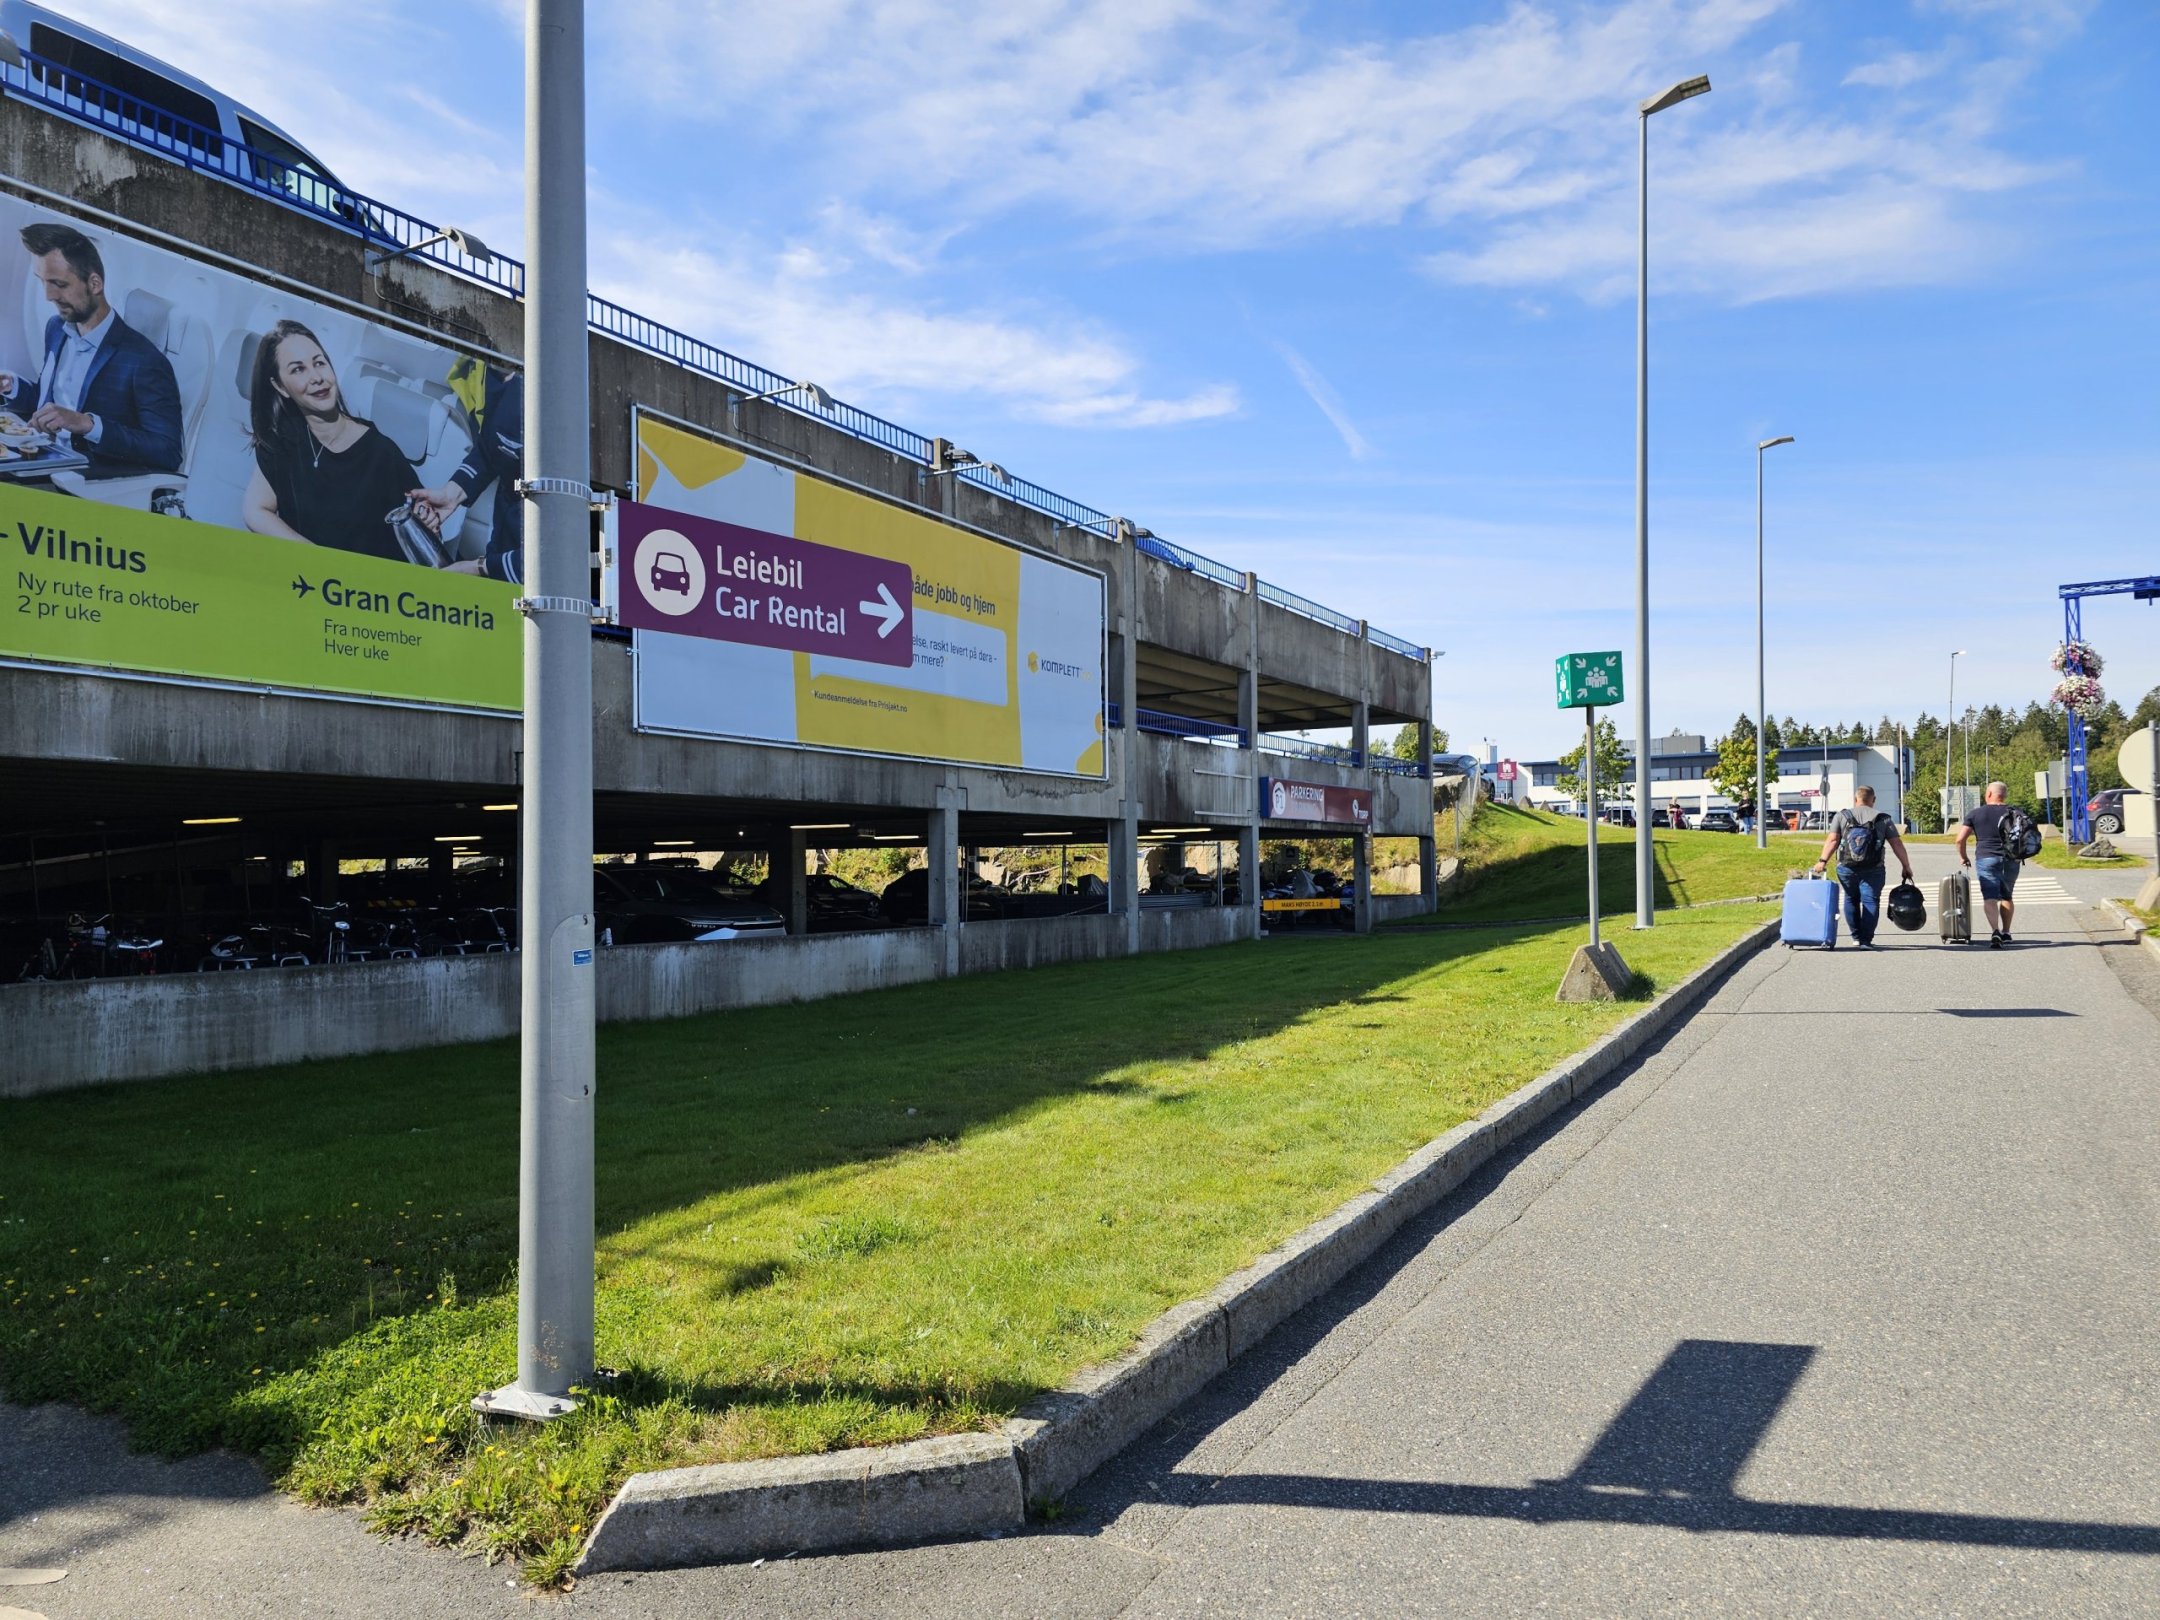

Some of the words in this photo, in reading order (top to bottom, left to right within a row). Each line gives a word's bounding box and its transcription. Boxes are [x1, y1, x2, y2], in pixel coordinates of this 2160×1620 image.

[716, 545, 803, 590] Leiebil
[18, 571, 47, 596] Ny
[53, 580, 93, 599] rute
[98, 584, 124, 604] fra
[129, 590, 200, 614] oktober
[322, 578, 389, 614] Gran
[397, 591, 494, 631] Canaria
[935, 582, 958, 605] jobb
[960, 594, 972, 612] og
[973, 594, 996, 616] hjem
[18, 594, 31, 614] 2
[38, 600, 60, 620] pr
[65, 603, 101, 623] uke
[715, 586, 760, 621] Car
[768, 595, 846, 636] Rental
[324, 618, 348, 637] Fra
[351, 625, 423, 648] november
[324, 638, 359, 657] Hver
[363, 645, 390, 662] uke
[921, 655, 945, 668] mere?
[929, 640, 949, 653] raskt
[950, 642, 969, 658] levert
[969, 647, 977, 661] på
[1041, 658, 1080, 679] KOMPLETT
[814, 689, 868, 707] Kundeanmeldelse
[868, 698, 878, 709] fra
[1290, 785, 1324, 802] PARKERING
